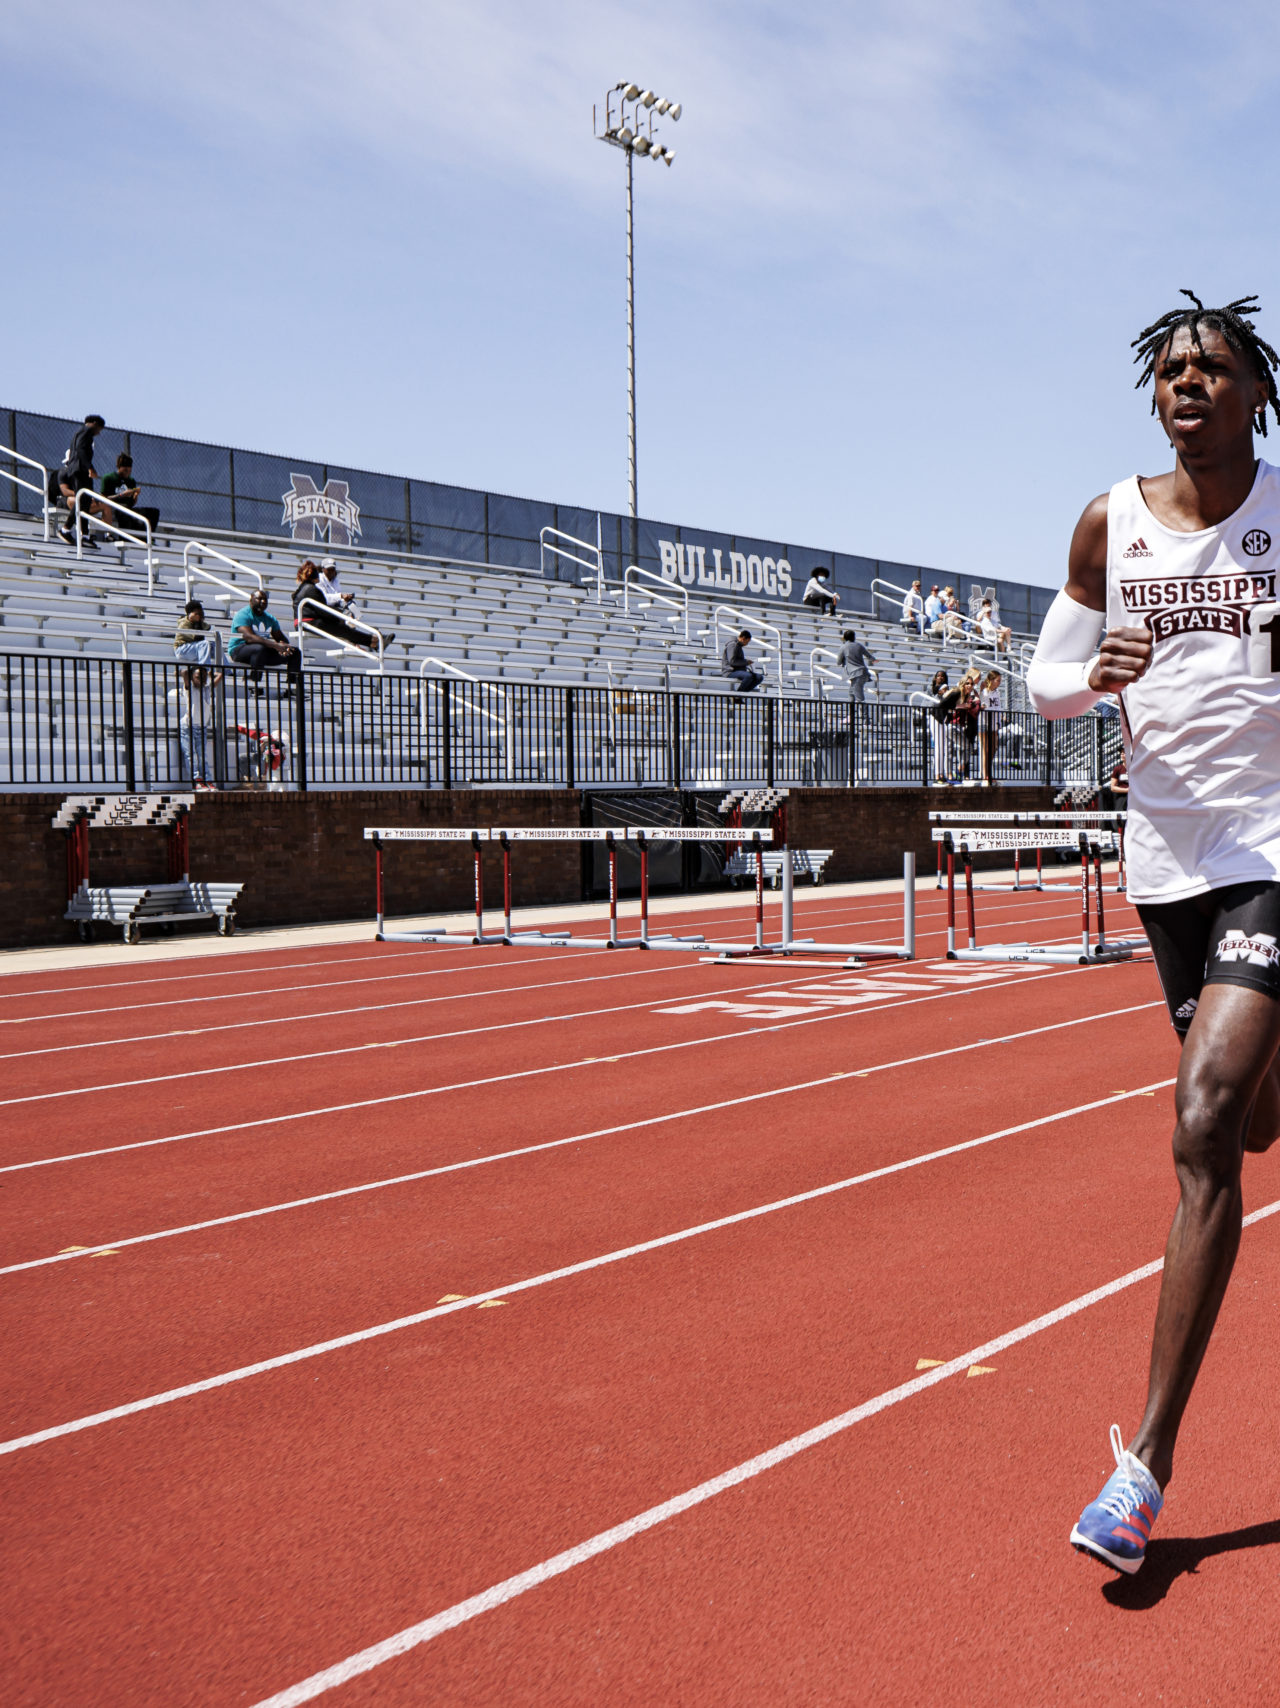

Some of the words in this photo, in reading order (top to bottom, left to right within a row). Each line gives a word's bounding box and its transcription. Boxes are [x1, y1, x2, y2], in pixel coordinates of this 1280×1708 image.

[297, 498, 346, 521] STATE
[1245, 531, 1267, 554] SEC
[1123, 550, 1153, 558] adidas
[658, 540, 792, 597] BULLDOGS
[1121, 575, 1276, 607] MISSISSIPPI
[1160, 610, 1234, 636] STATE
[110, 811, 138, 819] UCS
[400, 830, 437, 838] MISSISSIPPI
[439, 830, 458, 838] STATE
[529, 830, 569, 838] MISSISSIPPI
[571, 830, 591, 838] STATE
[981, 831, 1030, 840] MISSISSIPPI
[1034, 831, 1059, 840] STATE
[1225, 940, 1269, 955] STATE
